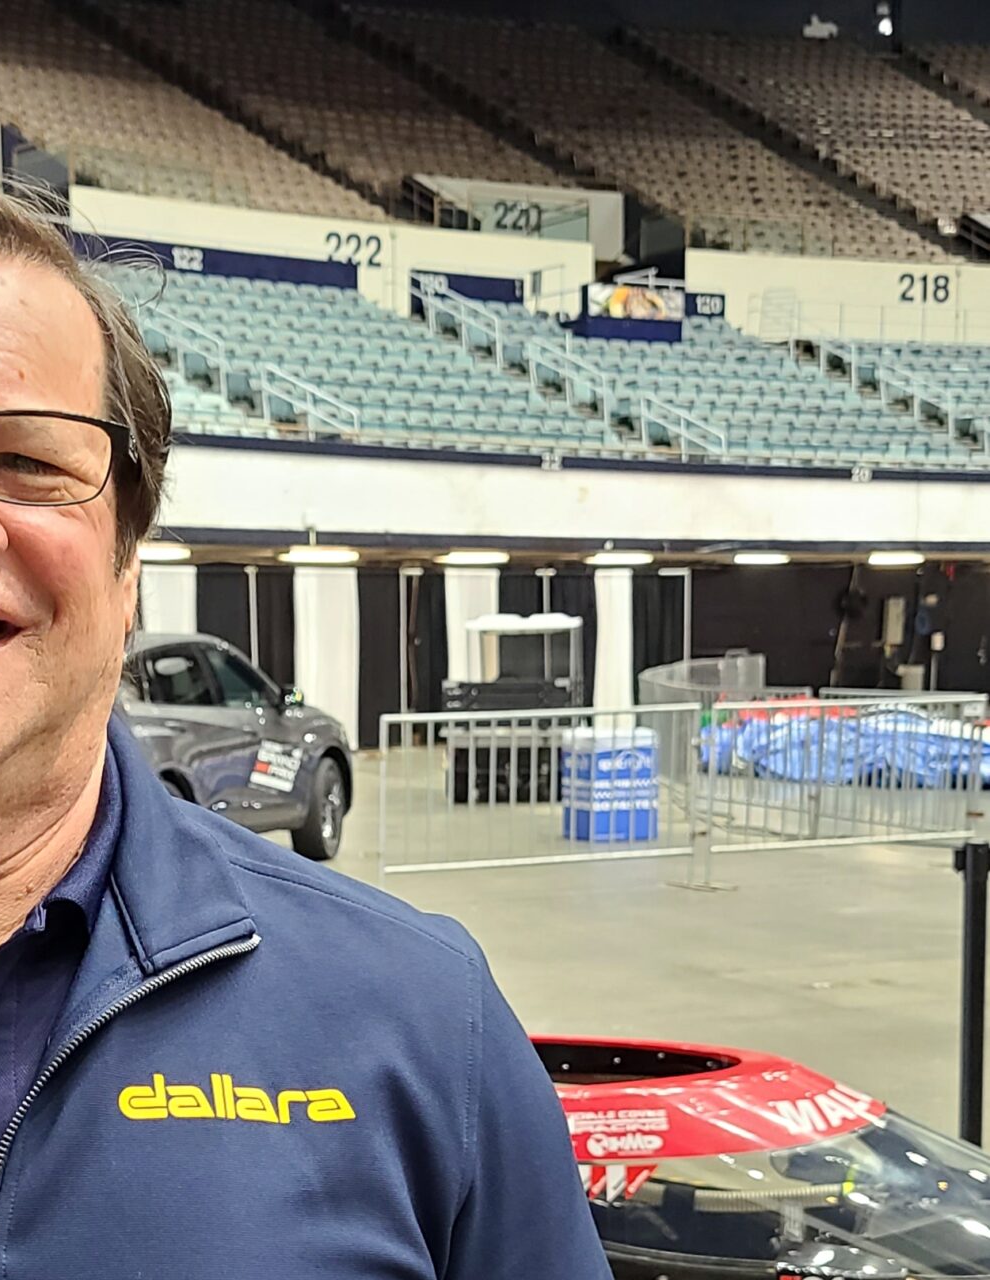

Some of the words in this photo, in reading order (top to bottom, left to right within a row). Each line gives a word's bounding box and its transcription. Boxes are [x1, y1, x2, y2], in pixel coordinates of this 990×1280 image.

[325, 232, 382, 267] 222
[899, 272, 950, 303] 218
[118, 1073, 356, 1124] dallara
